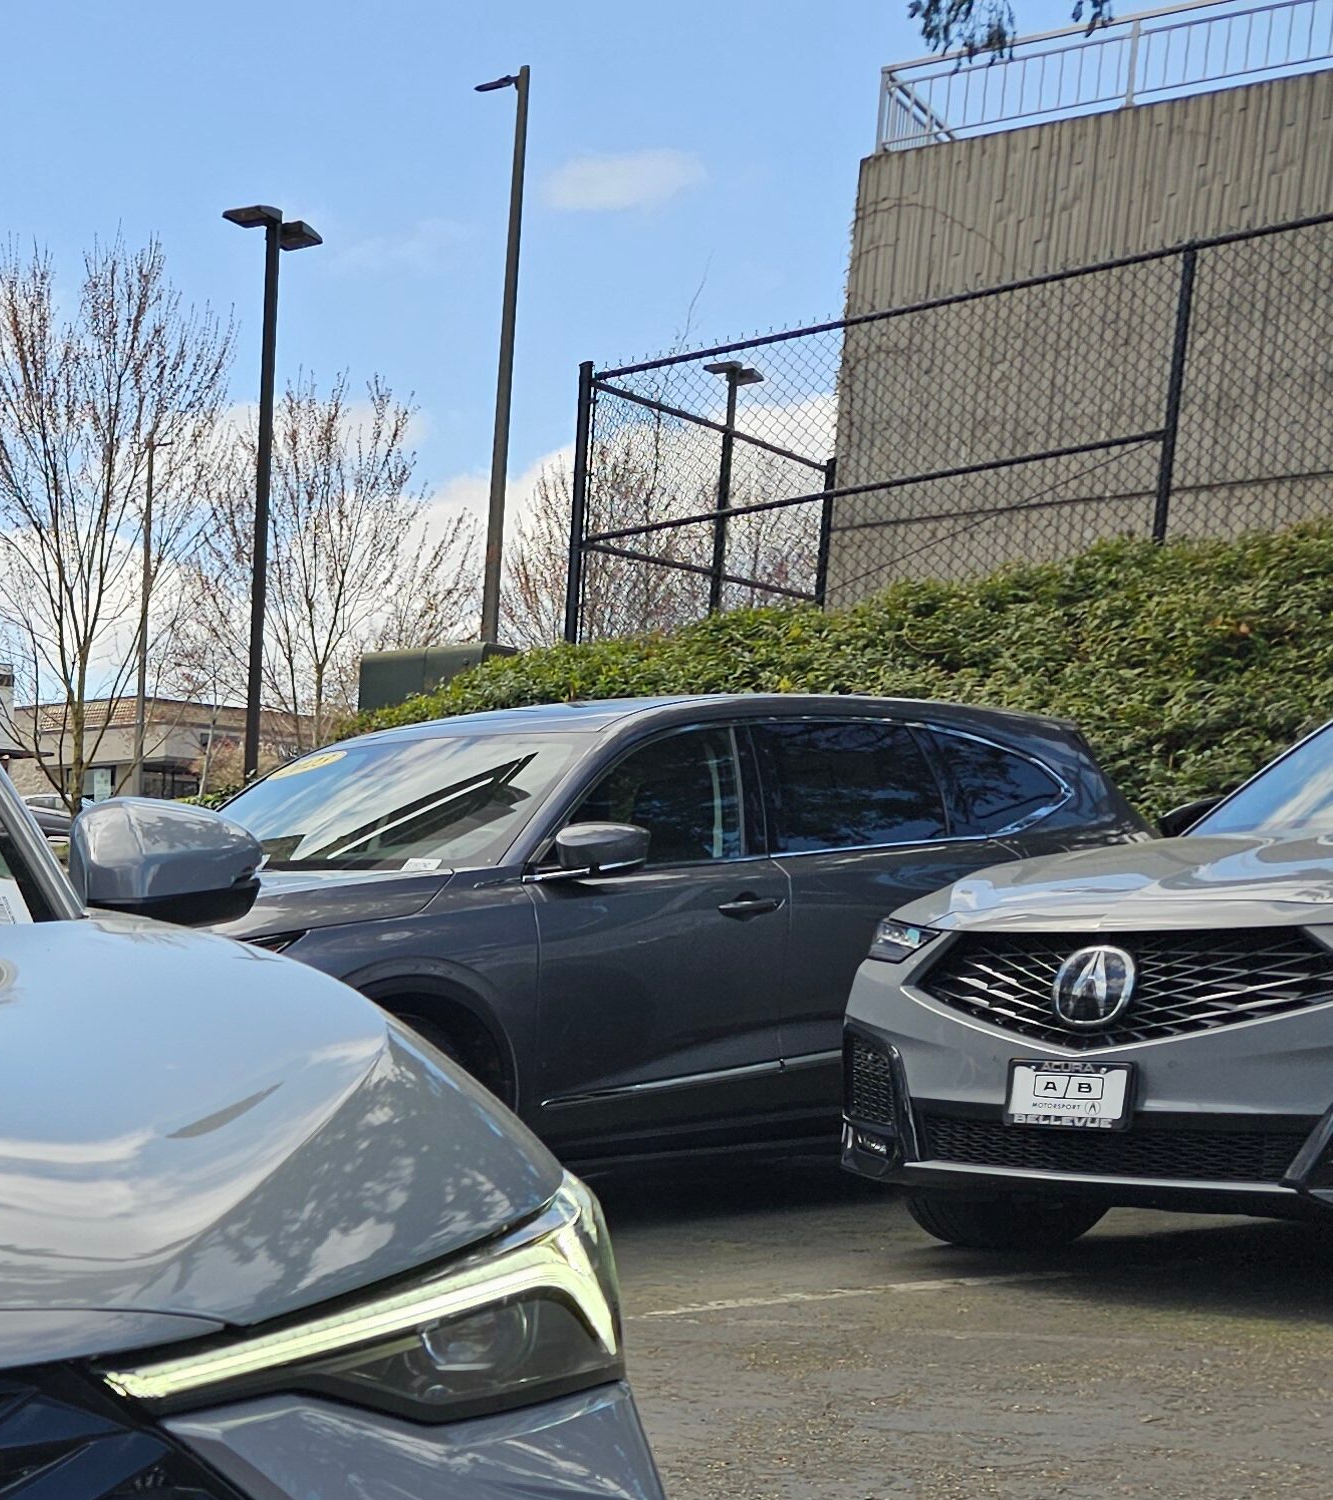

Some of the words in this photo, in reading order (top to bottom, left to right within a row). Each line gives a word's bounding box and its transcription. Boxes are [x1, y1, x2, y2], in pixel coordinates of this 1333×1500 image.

[1040, 1061, 1095, 1073] ACURA
[1032, 1102, 1082, 1110] MOTORSPORT
[1013, 1113, 1113, 1128] BELLEVUE
